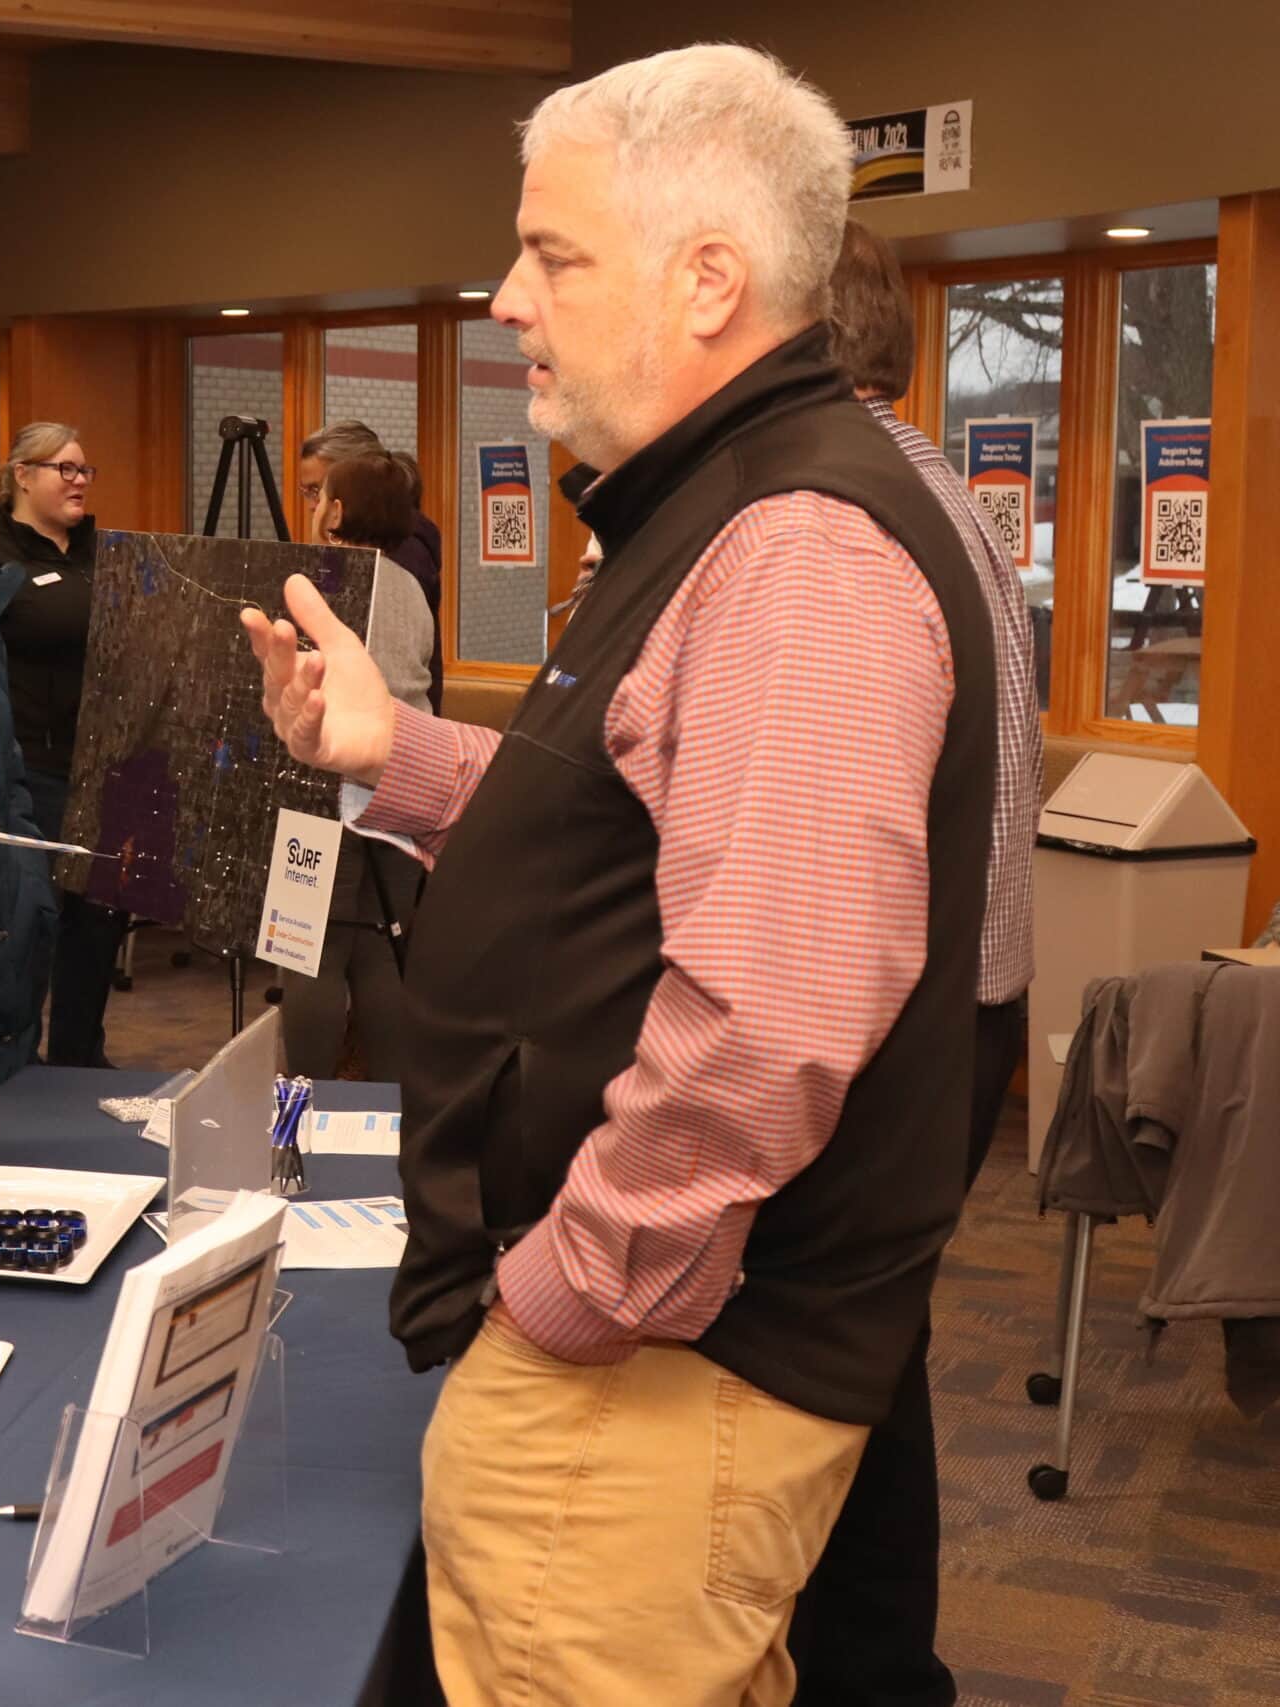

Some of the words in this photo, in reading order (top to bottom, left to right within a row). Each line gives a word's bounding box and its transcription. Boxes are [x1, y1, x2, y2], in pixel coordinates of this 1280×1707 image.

[884, 123, 908, 152] 2023
[1161, 448, 1188, 457] Register
[1189, 448, 1203, 456] Your
[978, 454, 1004, 463] Address
[1158, 458, 1185, 467] Address
[1186, 458, 1204, 468] Today
[287, 843, 322, 870] SURF
